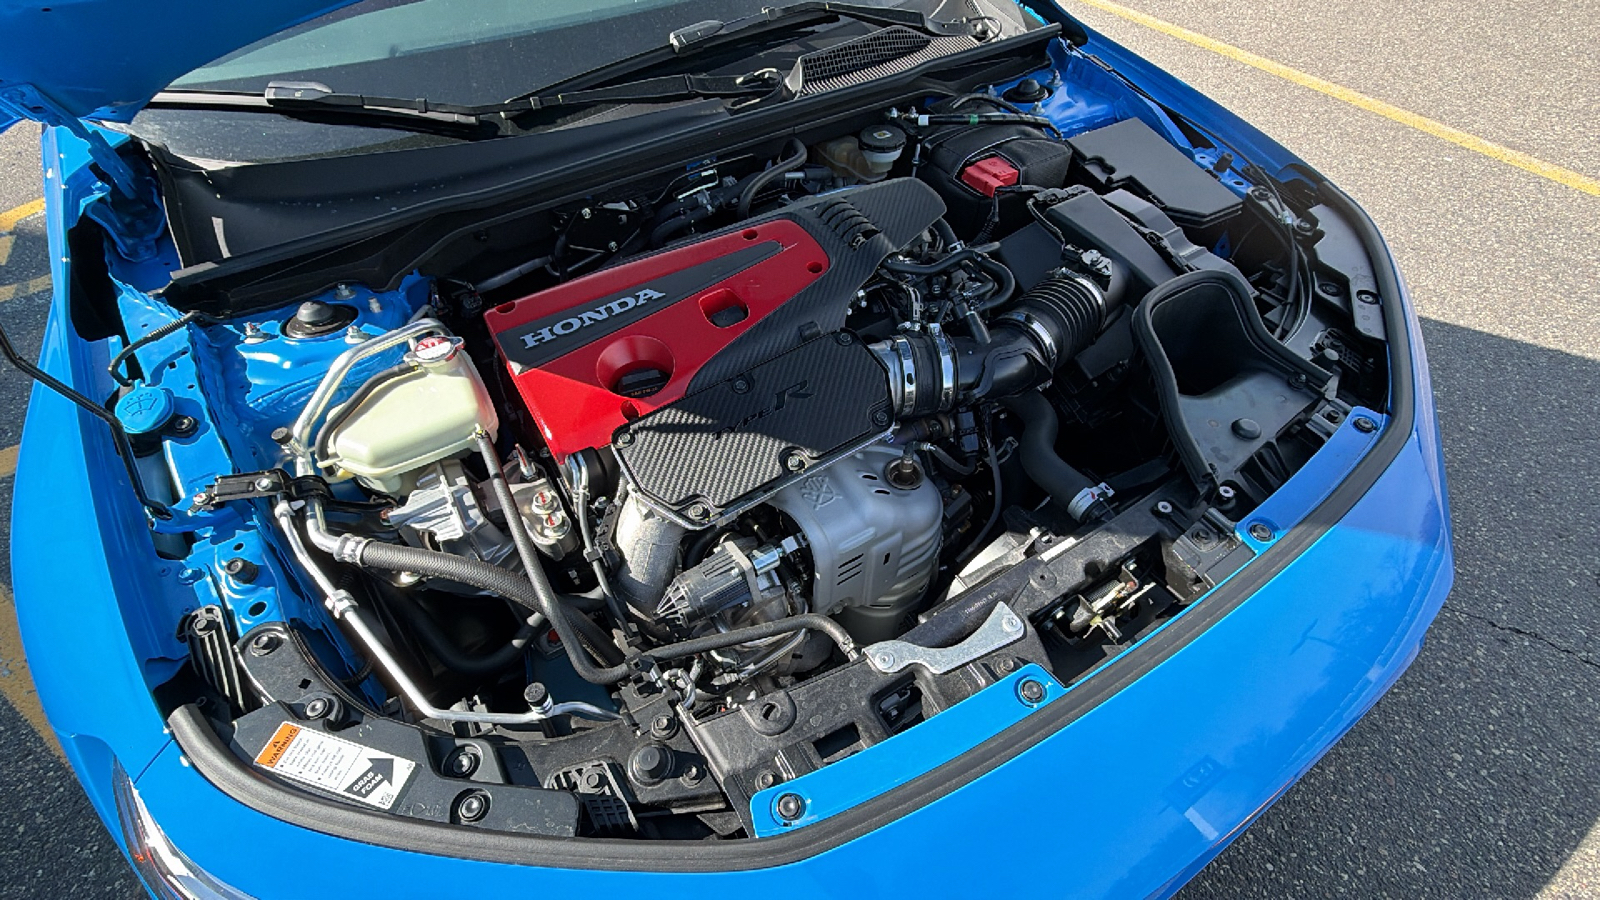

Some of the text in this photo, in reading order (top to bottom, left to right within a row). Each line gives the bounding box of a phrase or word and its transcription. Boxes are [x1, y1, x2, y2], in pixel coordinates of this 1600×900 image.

[520, 288, 666, 349] HONDA
[712, 380, 816, 440] TYPE R
[267, 728, 298, 764] WARNING
[353, 771, 374, 792] GRAB
[361, 773, 383, 794] FOAM
